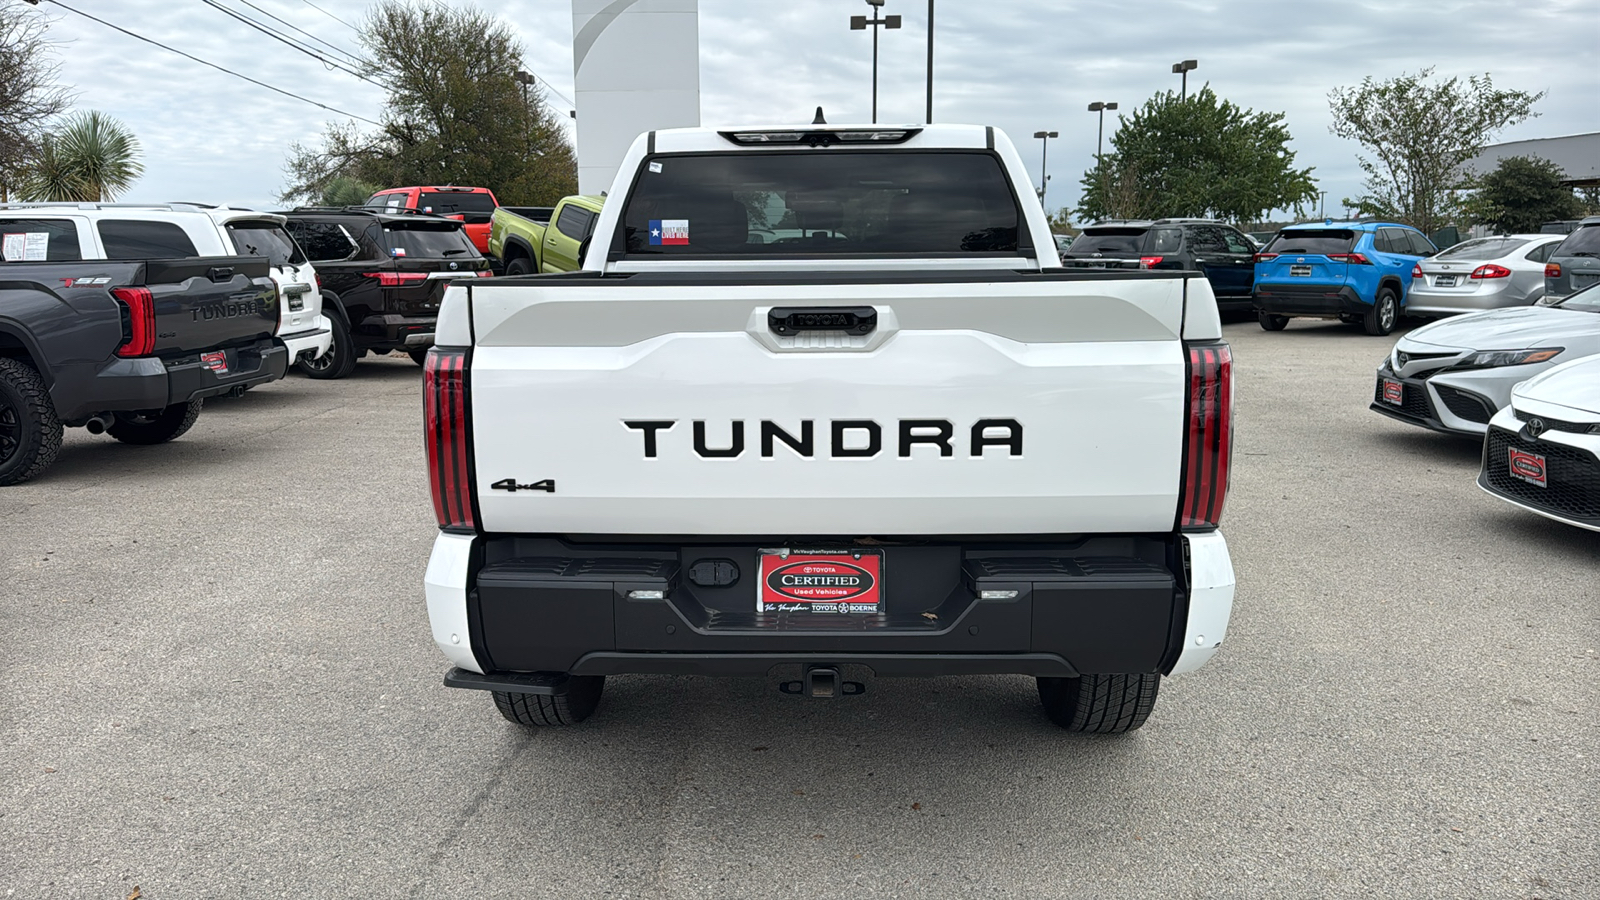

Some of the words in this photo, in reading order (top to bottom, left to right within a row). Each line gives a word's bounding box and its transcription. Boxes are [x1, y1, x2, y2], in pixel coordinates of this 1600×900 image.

[190, 302, 259, 322] TUNDRA
[798, 314, 848, 325] TOYOTA
[621, 418, 1024, 459] TUNDRA
[781, 574, 860, 586] CERTIFIED
